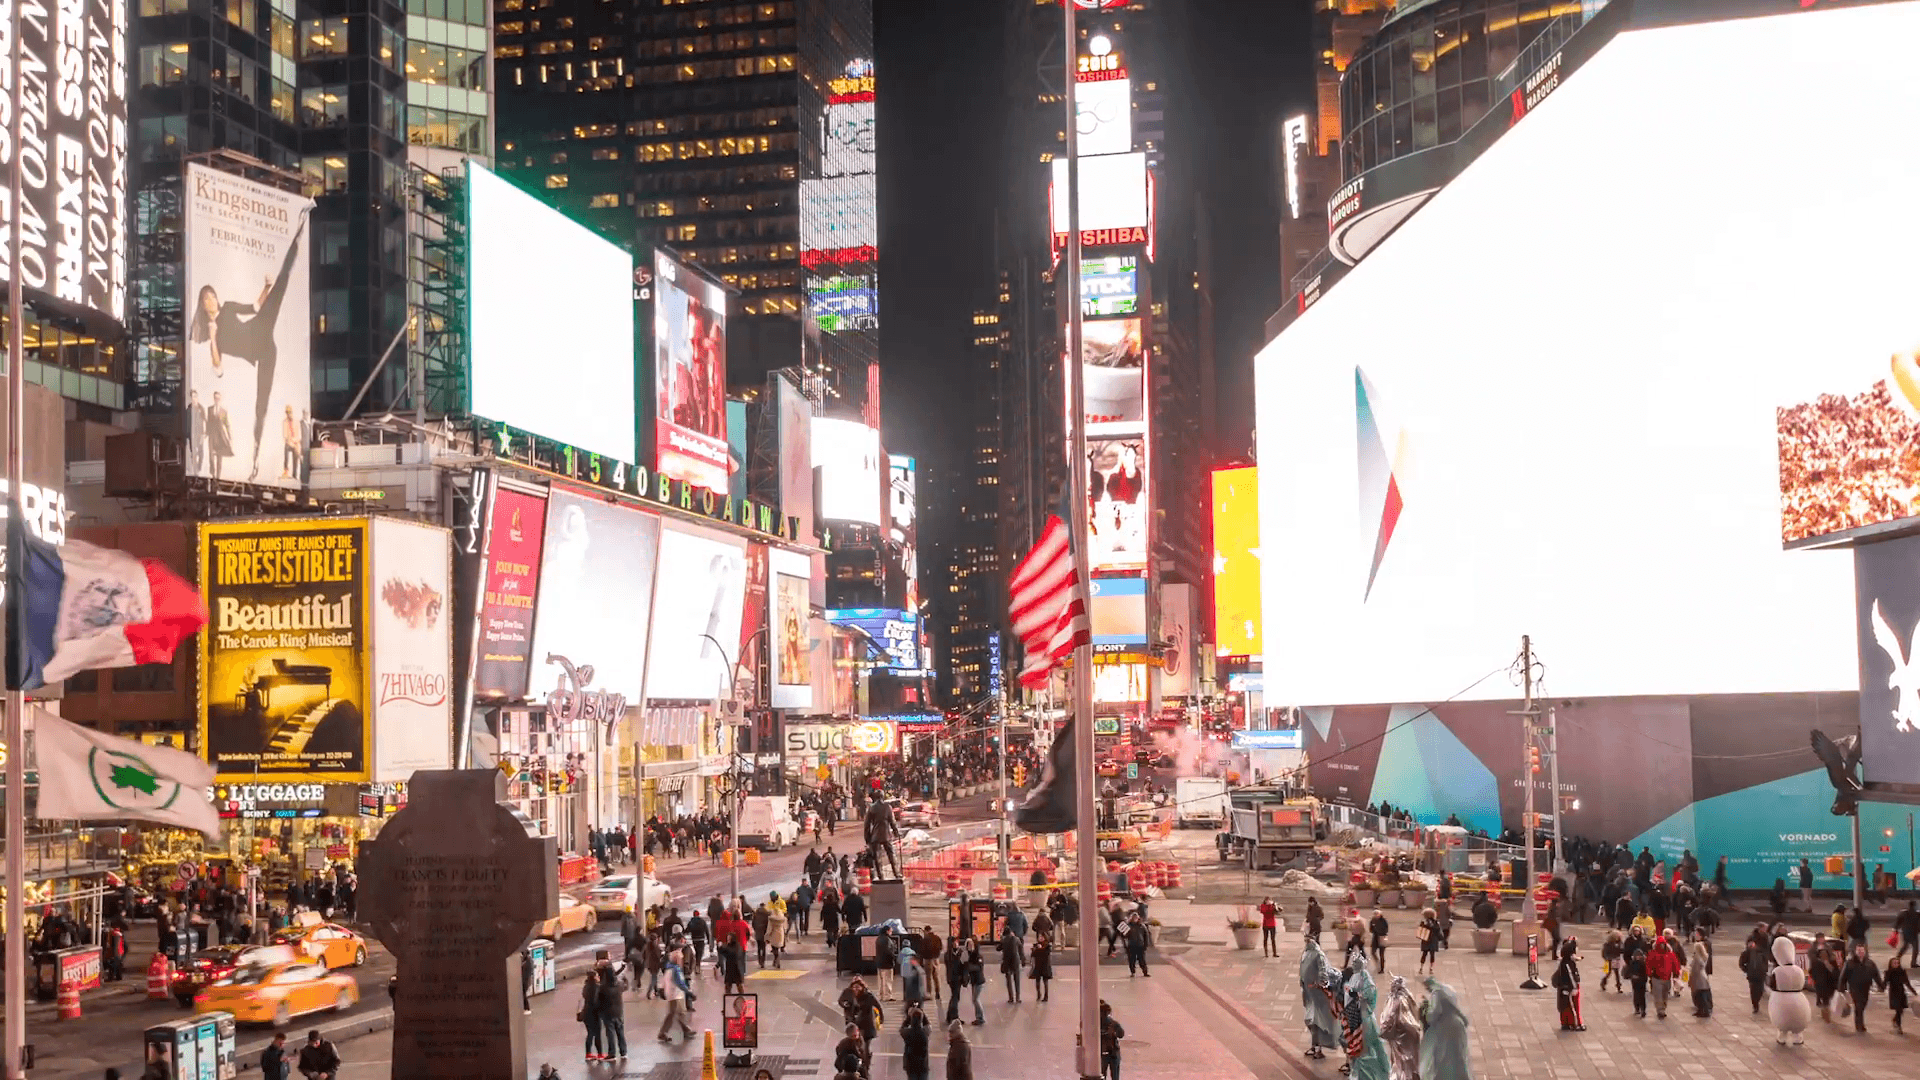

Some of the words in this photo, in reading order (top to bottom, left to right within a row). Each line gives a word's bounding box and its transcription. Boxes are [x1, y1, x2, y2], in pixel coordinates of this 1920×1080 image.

[1525, 51, 1562, 93] MARRIOTT
[1526, 75, 1559, 110] MARQUIS
[196, 176, 289, 224] Kingsman
[195, 202, 213, 214] THE
[218, 208, 250, 224] SECRET
[255, 218, 289, 235] SERVICE
[21, 188, 47, 288] OW
[211, 227, 264, 250] FEBRUARY
[266, 243, 276, 254] 13
[1056, 227, 1145, 247] TSHIBA
[633, 288, 650, 300] LG
[563, 446, 648, 497] 1540
[657, 472, 801, 540] BROADWAY
[259, 537, 281, 551] JOINS
[283, 537, 297, 550] THE
[298, 535, 325, 550] RANKS
[326, 535, 337, 549] OF
[337, 535, 353, 549] THE
[218, 593, 353, 632] Beautiful
[218, 634, 240, 649] The
[241, 634, 278, 649] Carole
[279, 633, 306, 650] King
[308, 632, 353, 648] Musical
[380, 673, 446, 707] ZHIVAGO
[229, 785, 324, 801] LUGGAGE
[1514, 779, 1536, 788] CHAE
[1548, 782, 1577, 791] CSTANT
[1100, 840, 1119, 852] CAT
[395, 869, 447, 881] FRANCIS
[465, 869, 508, 881] DUFFY
